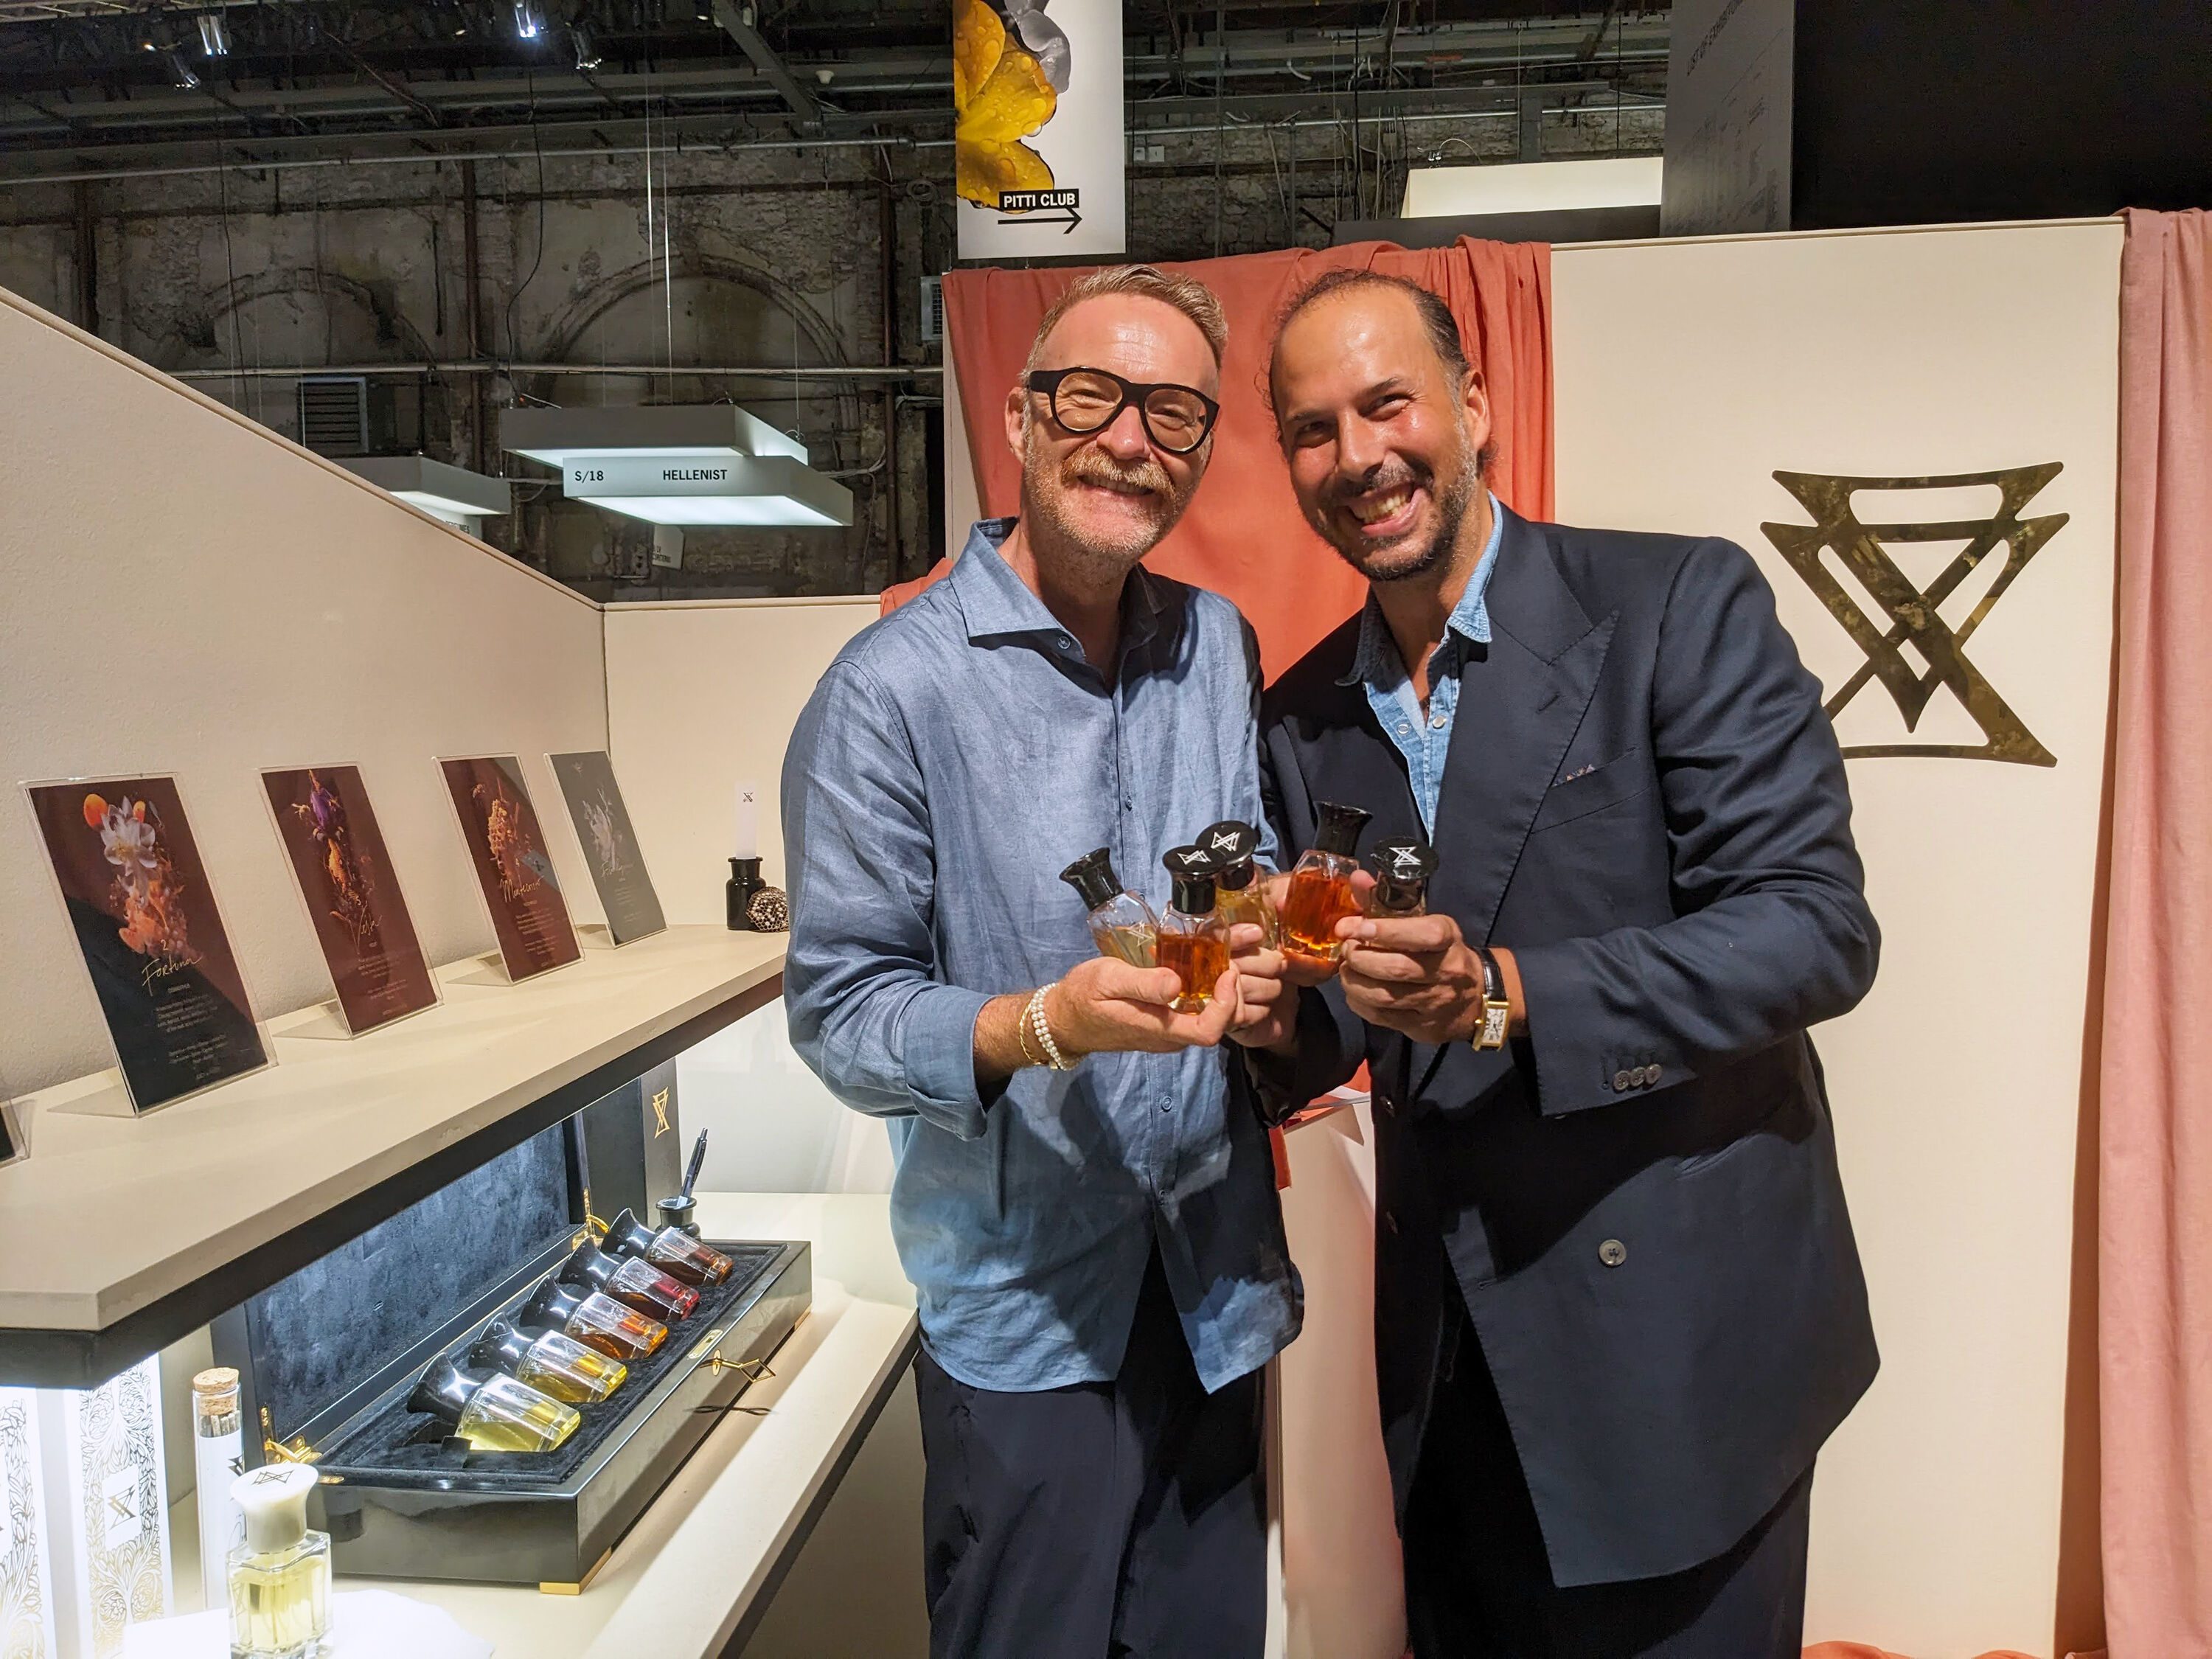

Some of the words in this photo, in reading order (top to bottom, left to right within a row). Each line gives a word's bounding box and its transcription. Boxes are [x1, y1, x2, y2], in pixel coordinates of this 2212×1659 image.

[1004, 194, 1036, 208] PITTI
[1040, 192, 1076, 206] CLUB
[574, 470, 604, 483] S/18
[663, 470, 728, 481] HELLENIST
[161, 939, 169, 950] 2
